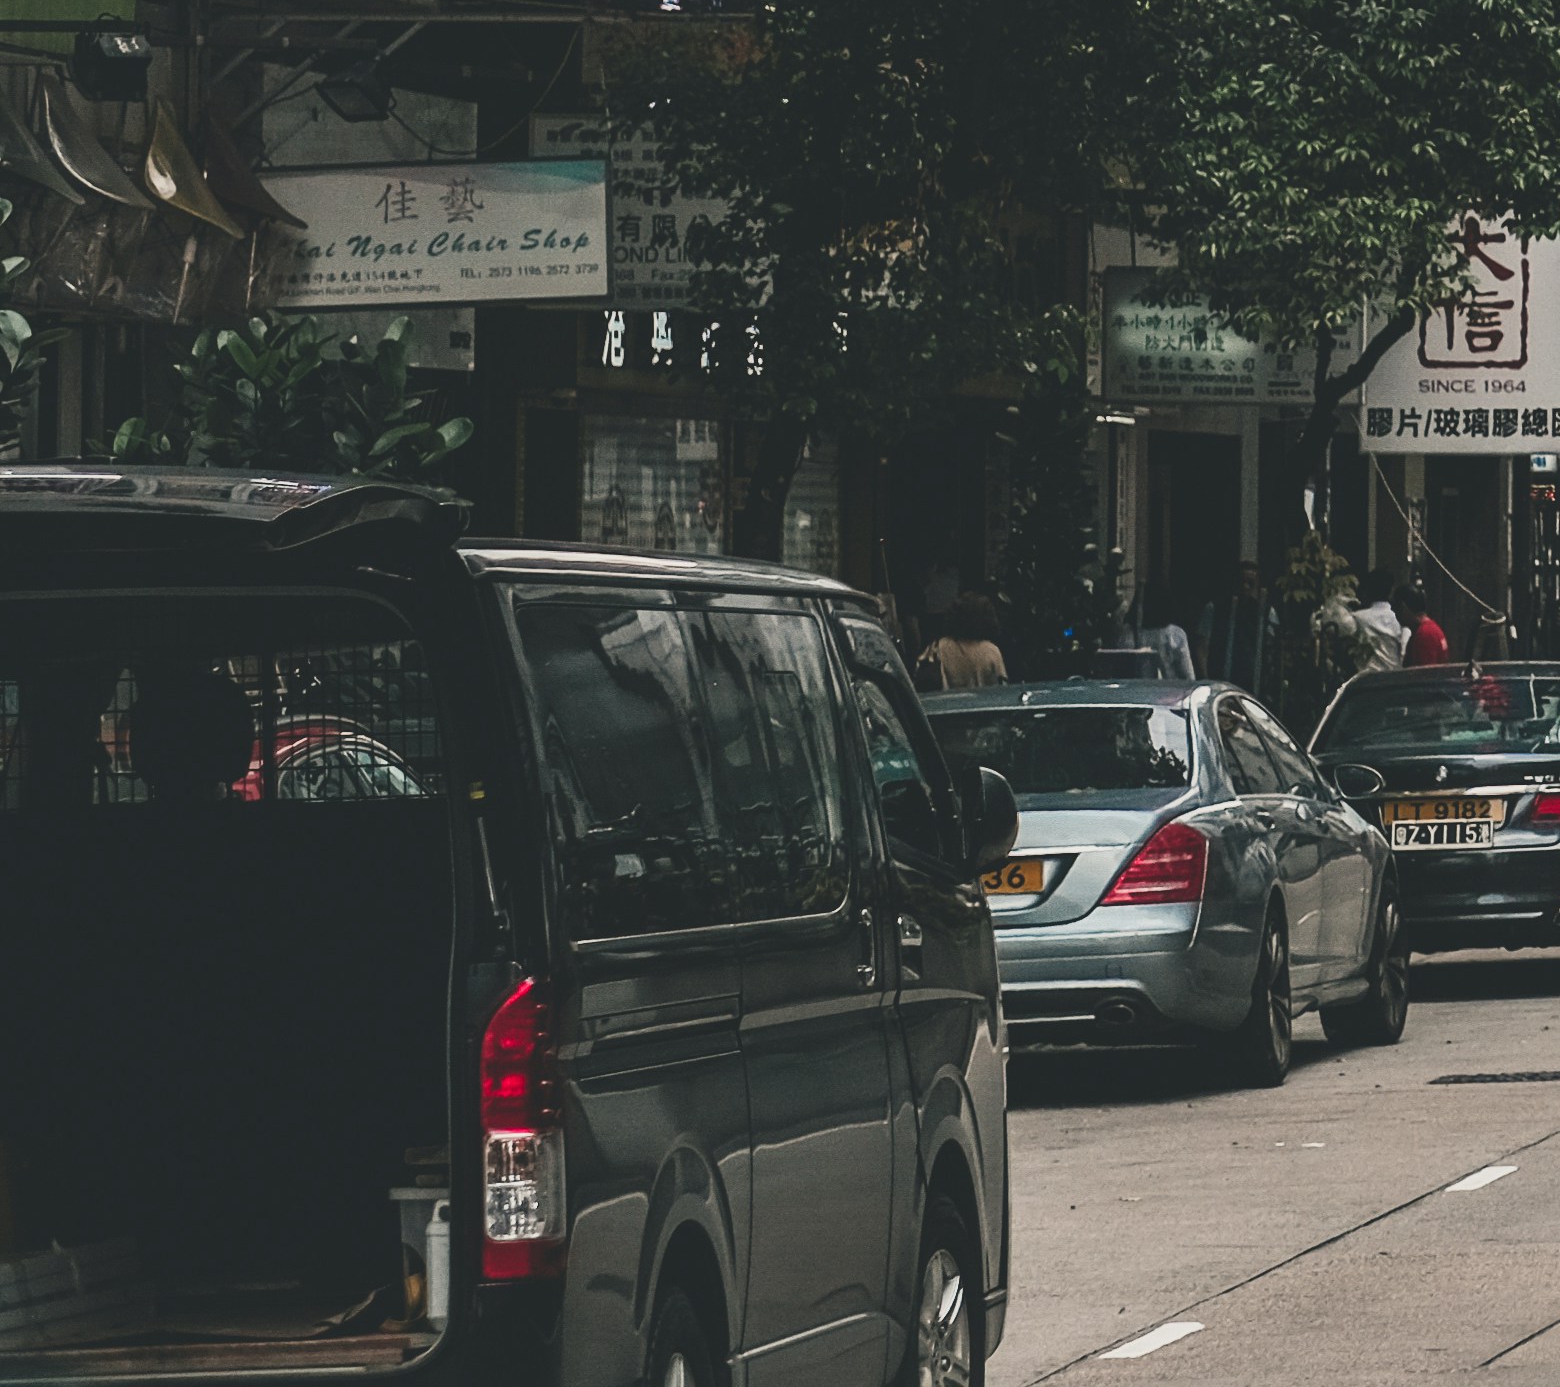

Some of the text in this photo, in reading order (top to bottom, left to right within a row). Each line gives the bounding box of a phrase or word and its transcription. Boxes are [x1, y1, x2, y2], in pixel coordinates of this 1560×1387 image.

[375, 177, 484, 224] 佳藝
[346, 234, 419, 263] Ngai
[426, 231, 508, 258] Chair
[519, 228, 591, 254] Shop
[1418, 379, 1527, 394] SINCE 1964
[1393, 799, 1491, 821] LT 9182
